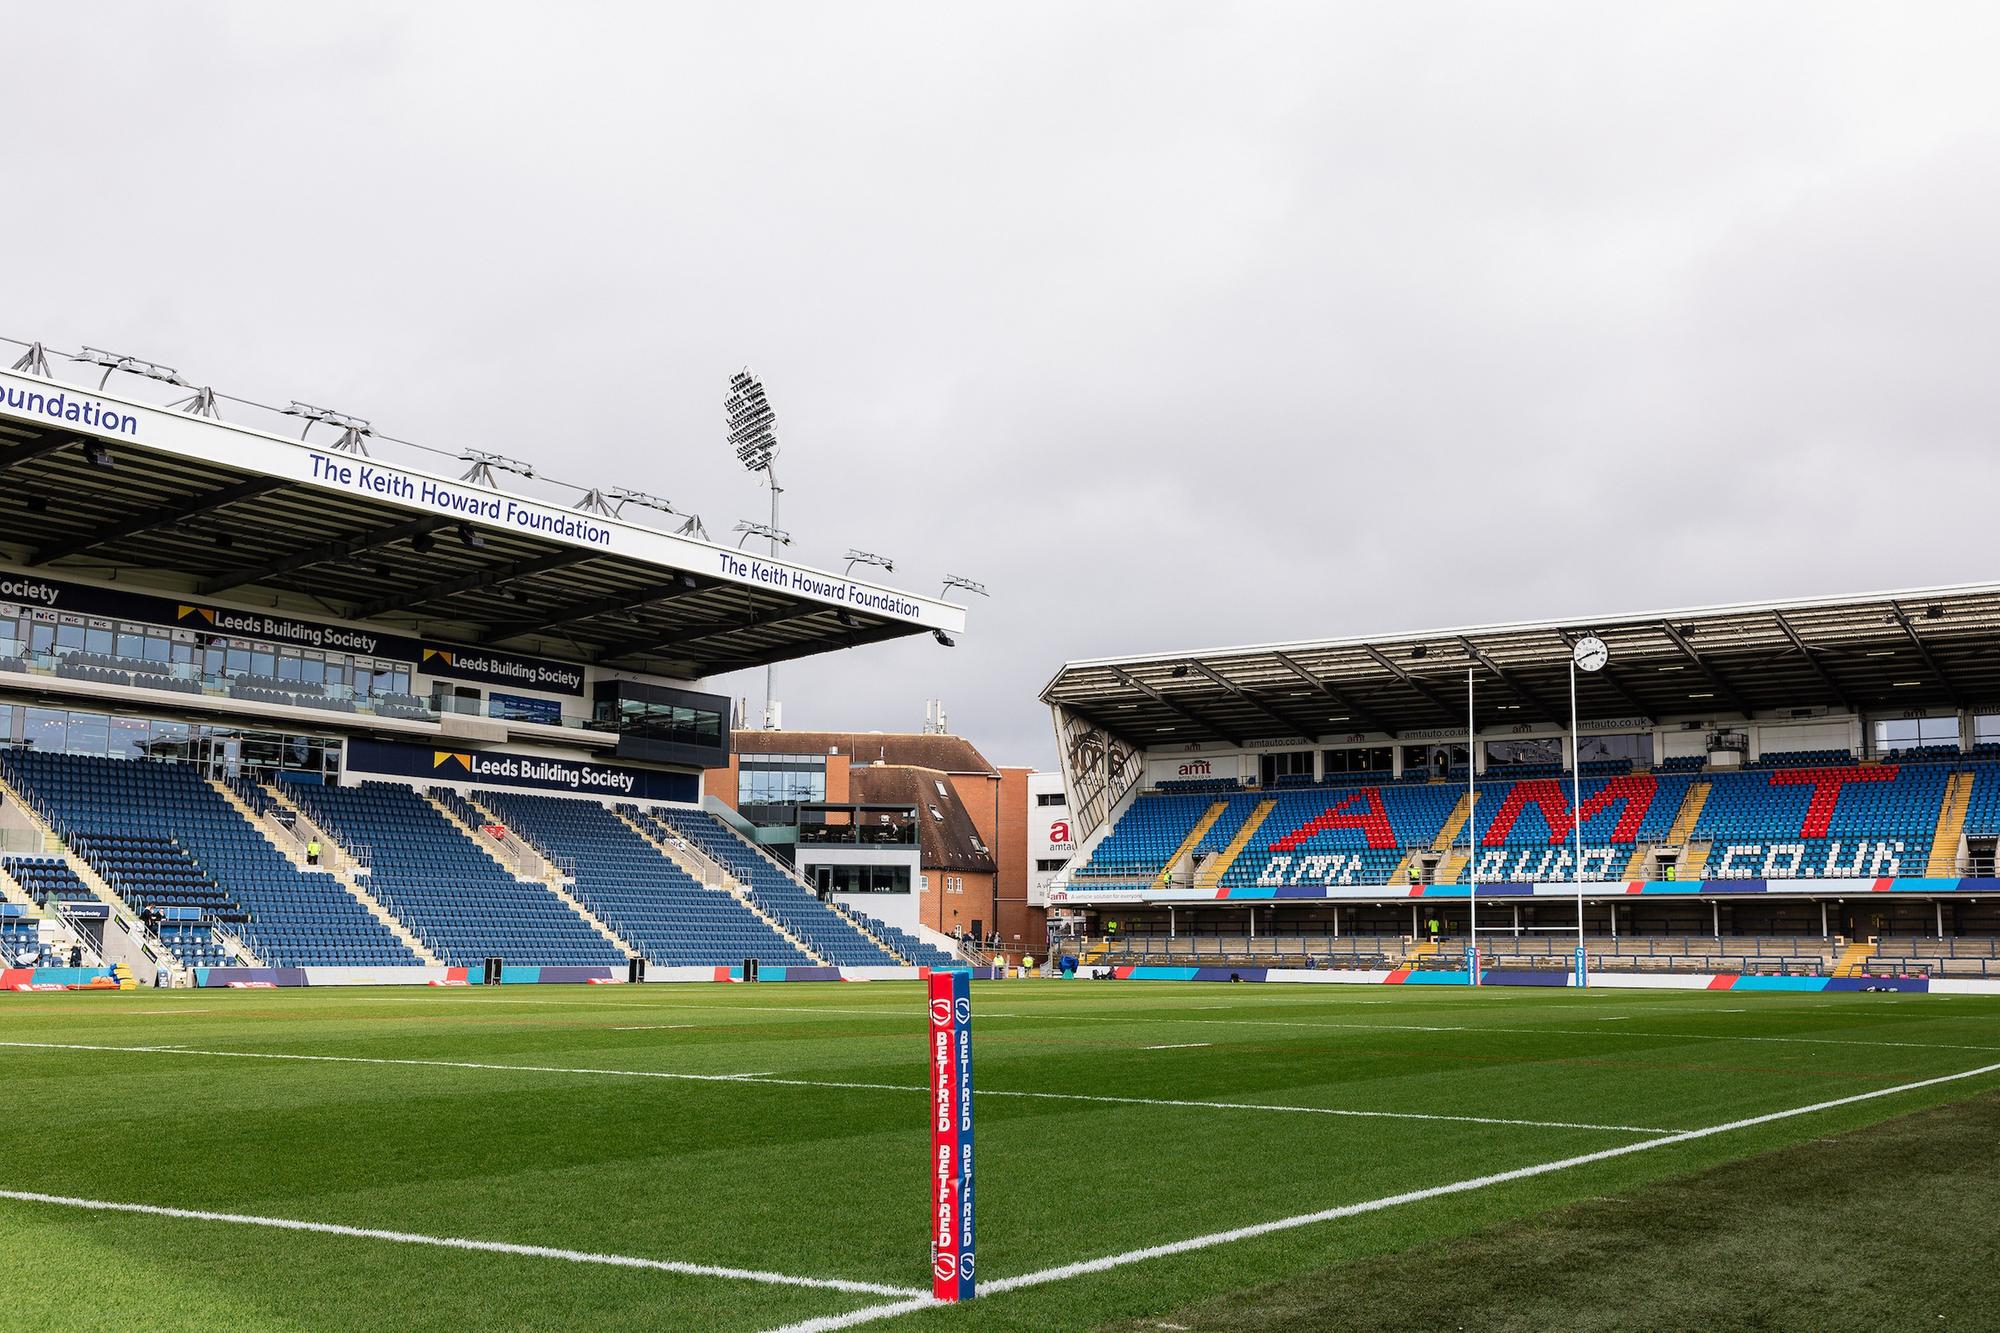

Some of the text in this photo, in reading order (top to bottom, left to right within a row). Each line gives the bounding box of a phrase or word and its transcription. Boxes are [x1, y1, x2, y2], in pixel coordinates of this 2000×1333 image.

[309, 453, 610, 545] The Keith Howard Foundation
[0, 580, 59, 605] ociety
[719, 553, 920, 618] The Keith Howard Foundation
[215, 611, 377, 654] Leeds Building Society
[452, 653, 580, 689] Leeds Building Society
[471, 755, 635, 793] Leeds Building Society
[1178, 761, 1212, 776] amt
[1050, 892, 1068, 901] amt
[937, 1031, 951, 1132] BETFRED
[959, 1030, 971, 1131] BETFRED
[938, 1144, 952, 1247] BETFRED
[962, 1144, 972, 1247] BETFRED
